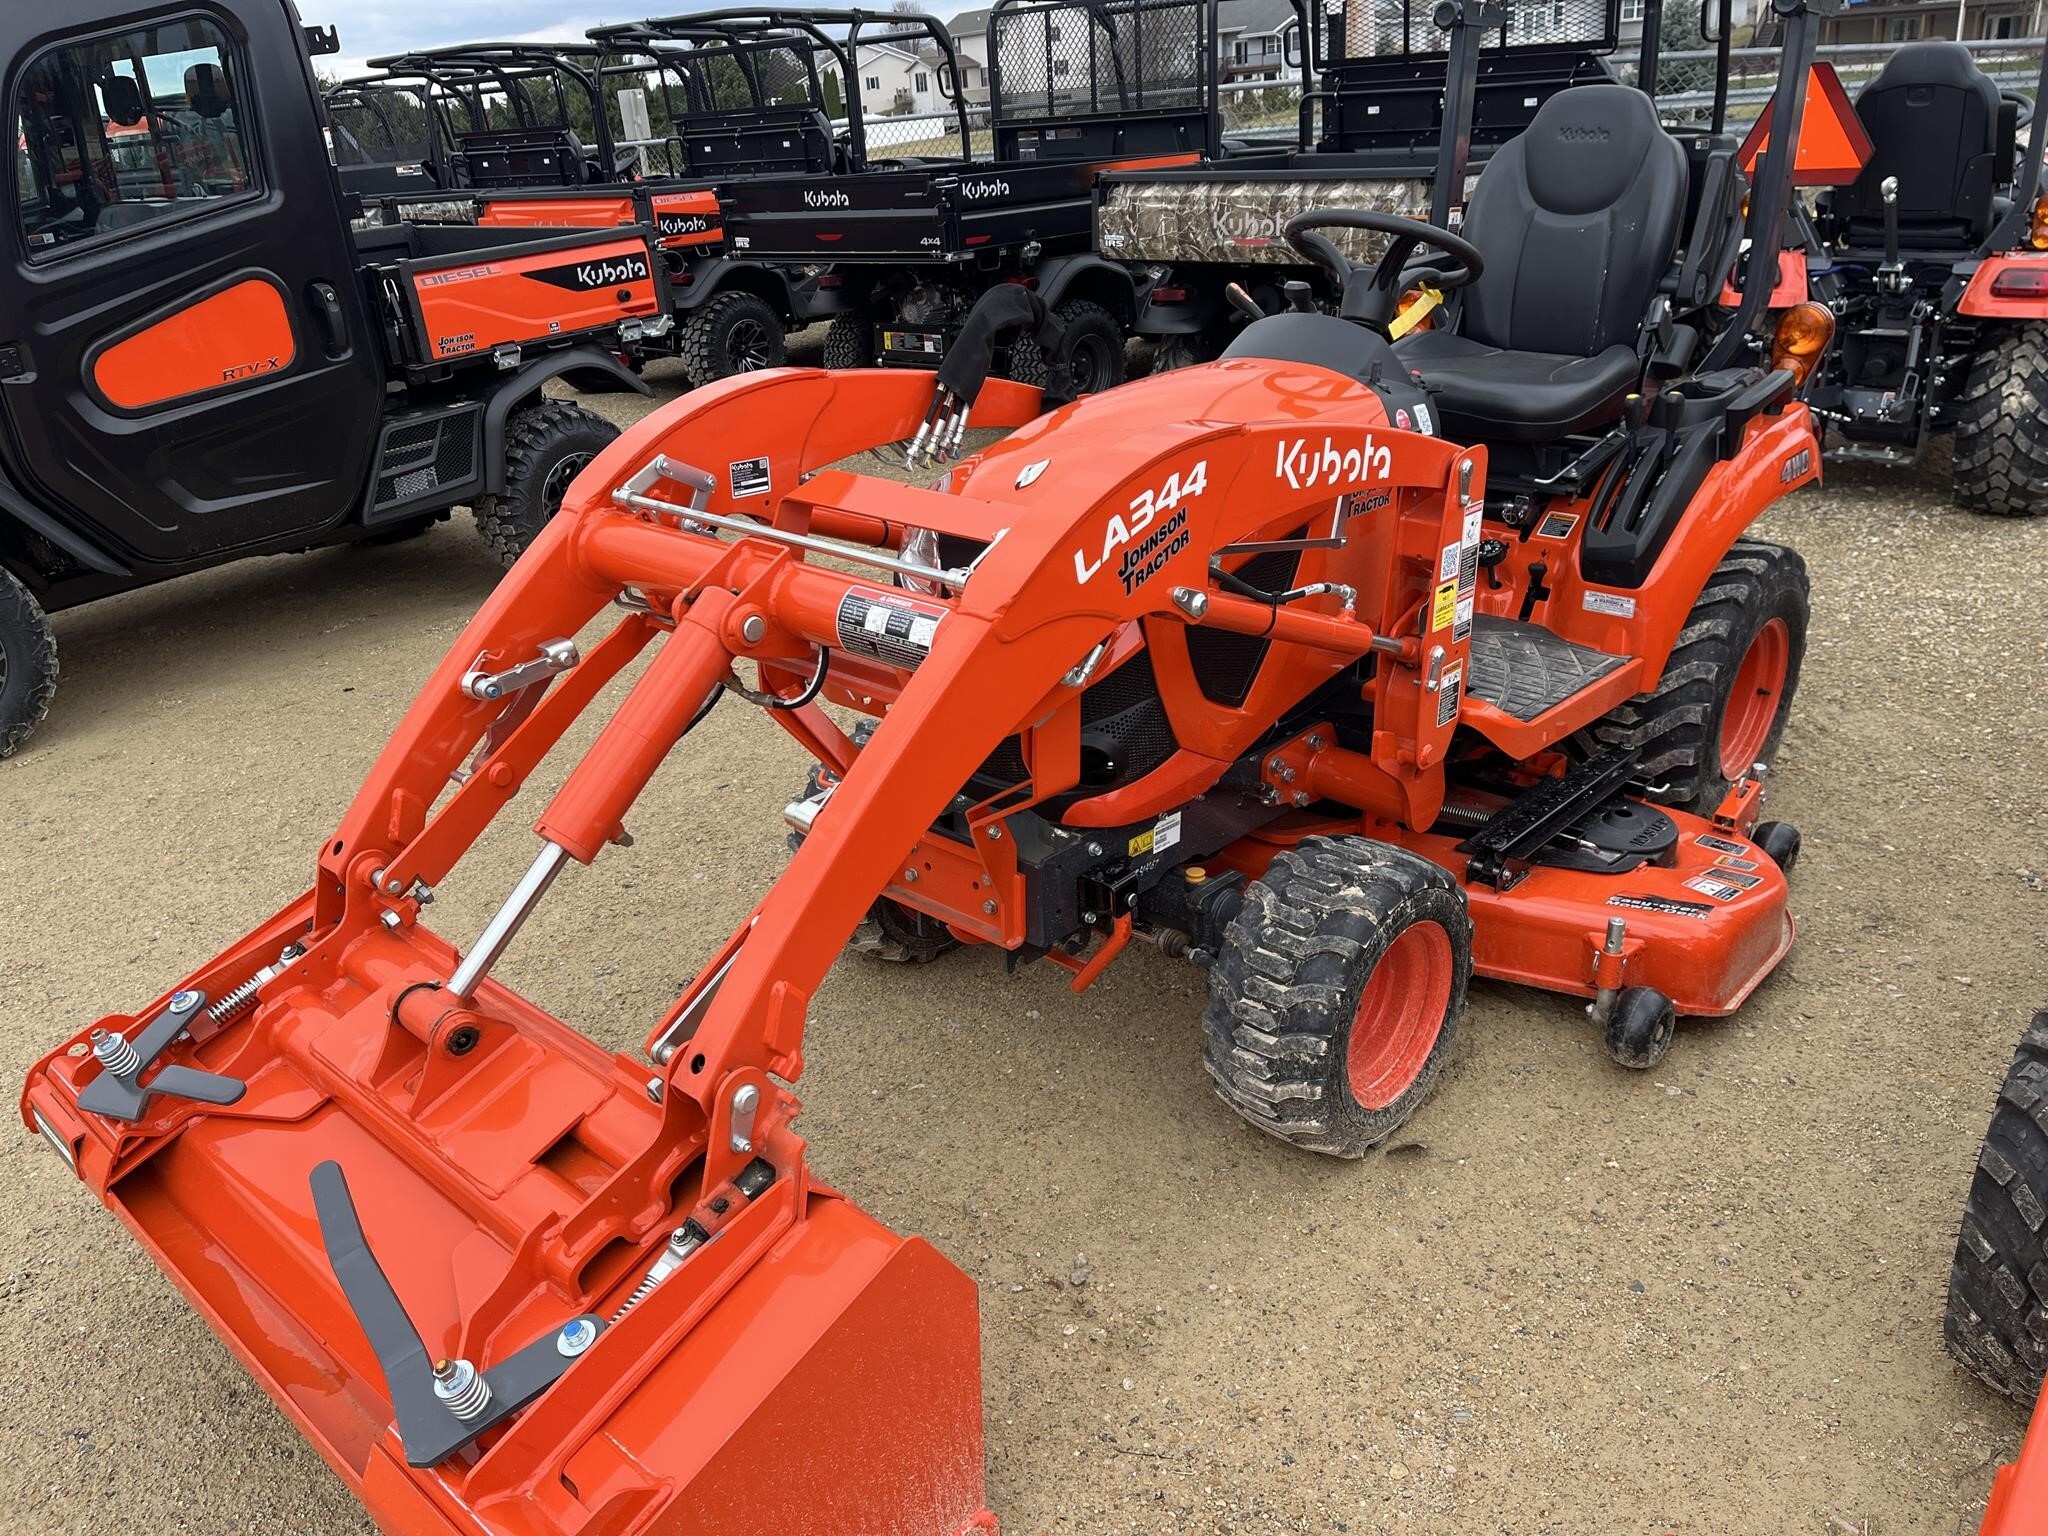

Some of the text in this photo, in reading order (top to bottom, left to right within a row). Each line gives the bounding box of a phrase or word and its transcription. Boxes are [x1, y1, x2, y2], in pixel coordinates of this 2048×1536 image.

[804, 190, 850, 208] Kubota
[962, 179, 1010, 200] Kubota
[660, 217, 707, 235] Kubota
[1212, 209, 1285, 237] Kubot
[920, 237, 942, 247] 4x4
[1105, 239, 1125, 248] IRS
[421, 266, 501, 287] DIESEL
[576, 258, 647, 287] Kubota
[440, 342, 476, 355] TRACTOR
[223, 356, 279, 381] RTV-X
[1275, 433, 1392, 490] Kubota
[1780, 447, 1810, 484] 4WD
[1074, 459, 1208, 585] LA344
[1117, 507, 1188, 579] JOHNSON
[1121, 528, 1191, 597] TRACTOR
[1606, 900, 1709, 920] Mower Deck
